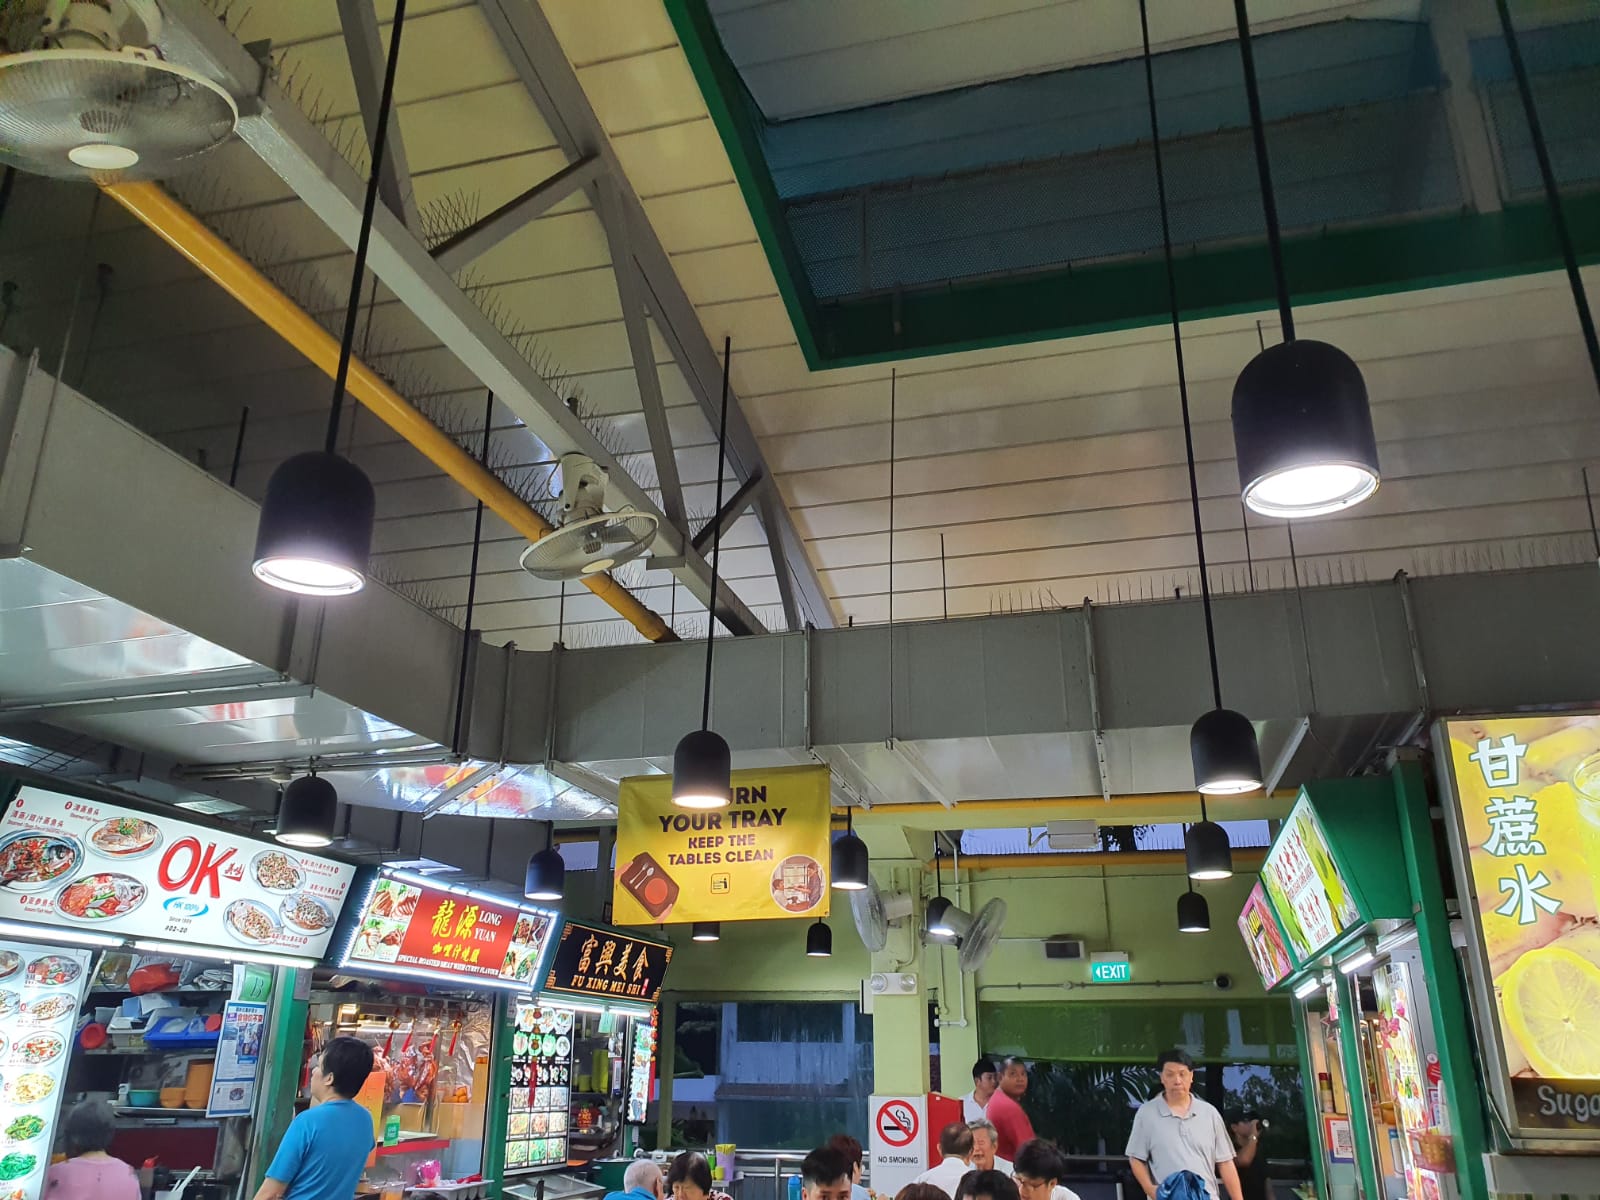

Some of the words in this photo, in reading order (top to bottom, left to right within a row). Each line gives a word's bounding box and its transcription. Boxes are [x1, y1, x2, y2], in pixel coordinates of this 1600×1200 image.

[659, 812, 722, 832] YOUR
[728, 807, 787, 828] TRAY
[1469, 733, 1563, 925] 甘蔗水
[688, 836, 724, 849] KEEP
[728, 834, 755, 847] THE
[668, 852, 722, 865] TABLES
[725, 848, 774, 863] CLEAN
[158, 835, 238, 898] OK
[478, 910, 502, 926] LONG
[474, 927, 496, 943] YUAN
[397, 954, 418, 964] SPECIAL
[1102, 964, 1126, 978] EXIT
[571, 974, 585, 987] FU
[586, 977, 609, 991] XING
[610, 980, 625, 993] MEI
[626, 983, 641, 995] SHI
[878, 1156, 887, 1164] NO
[889, 1156, 919, 1164] SMOKING
